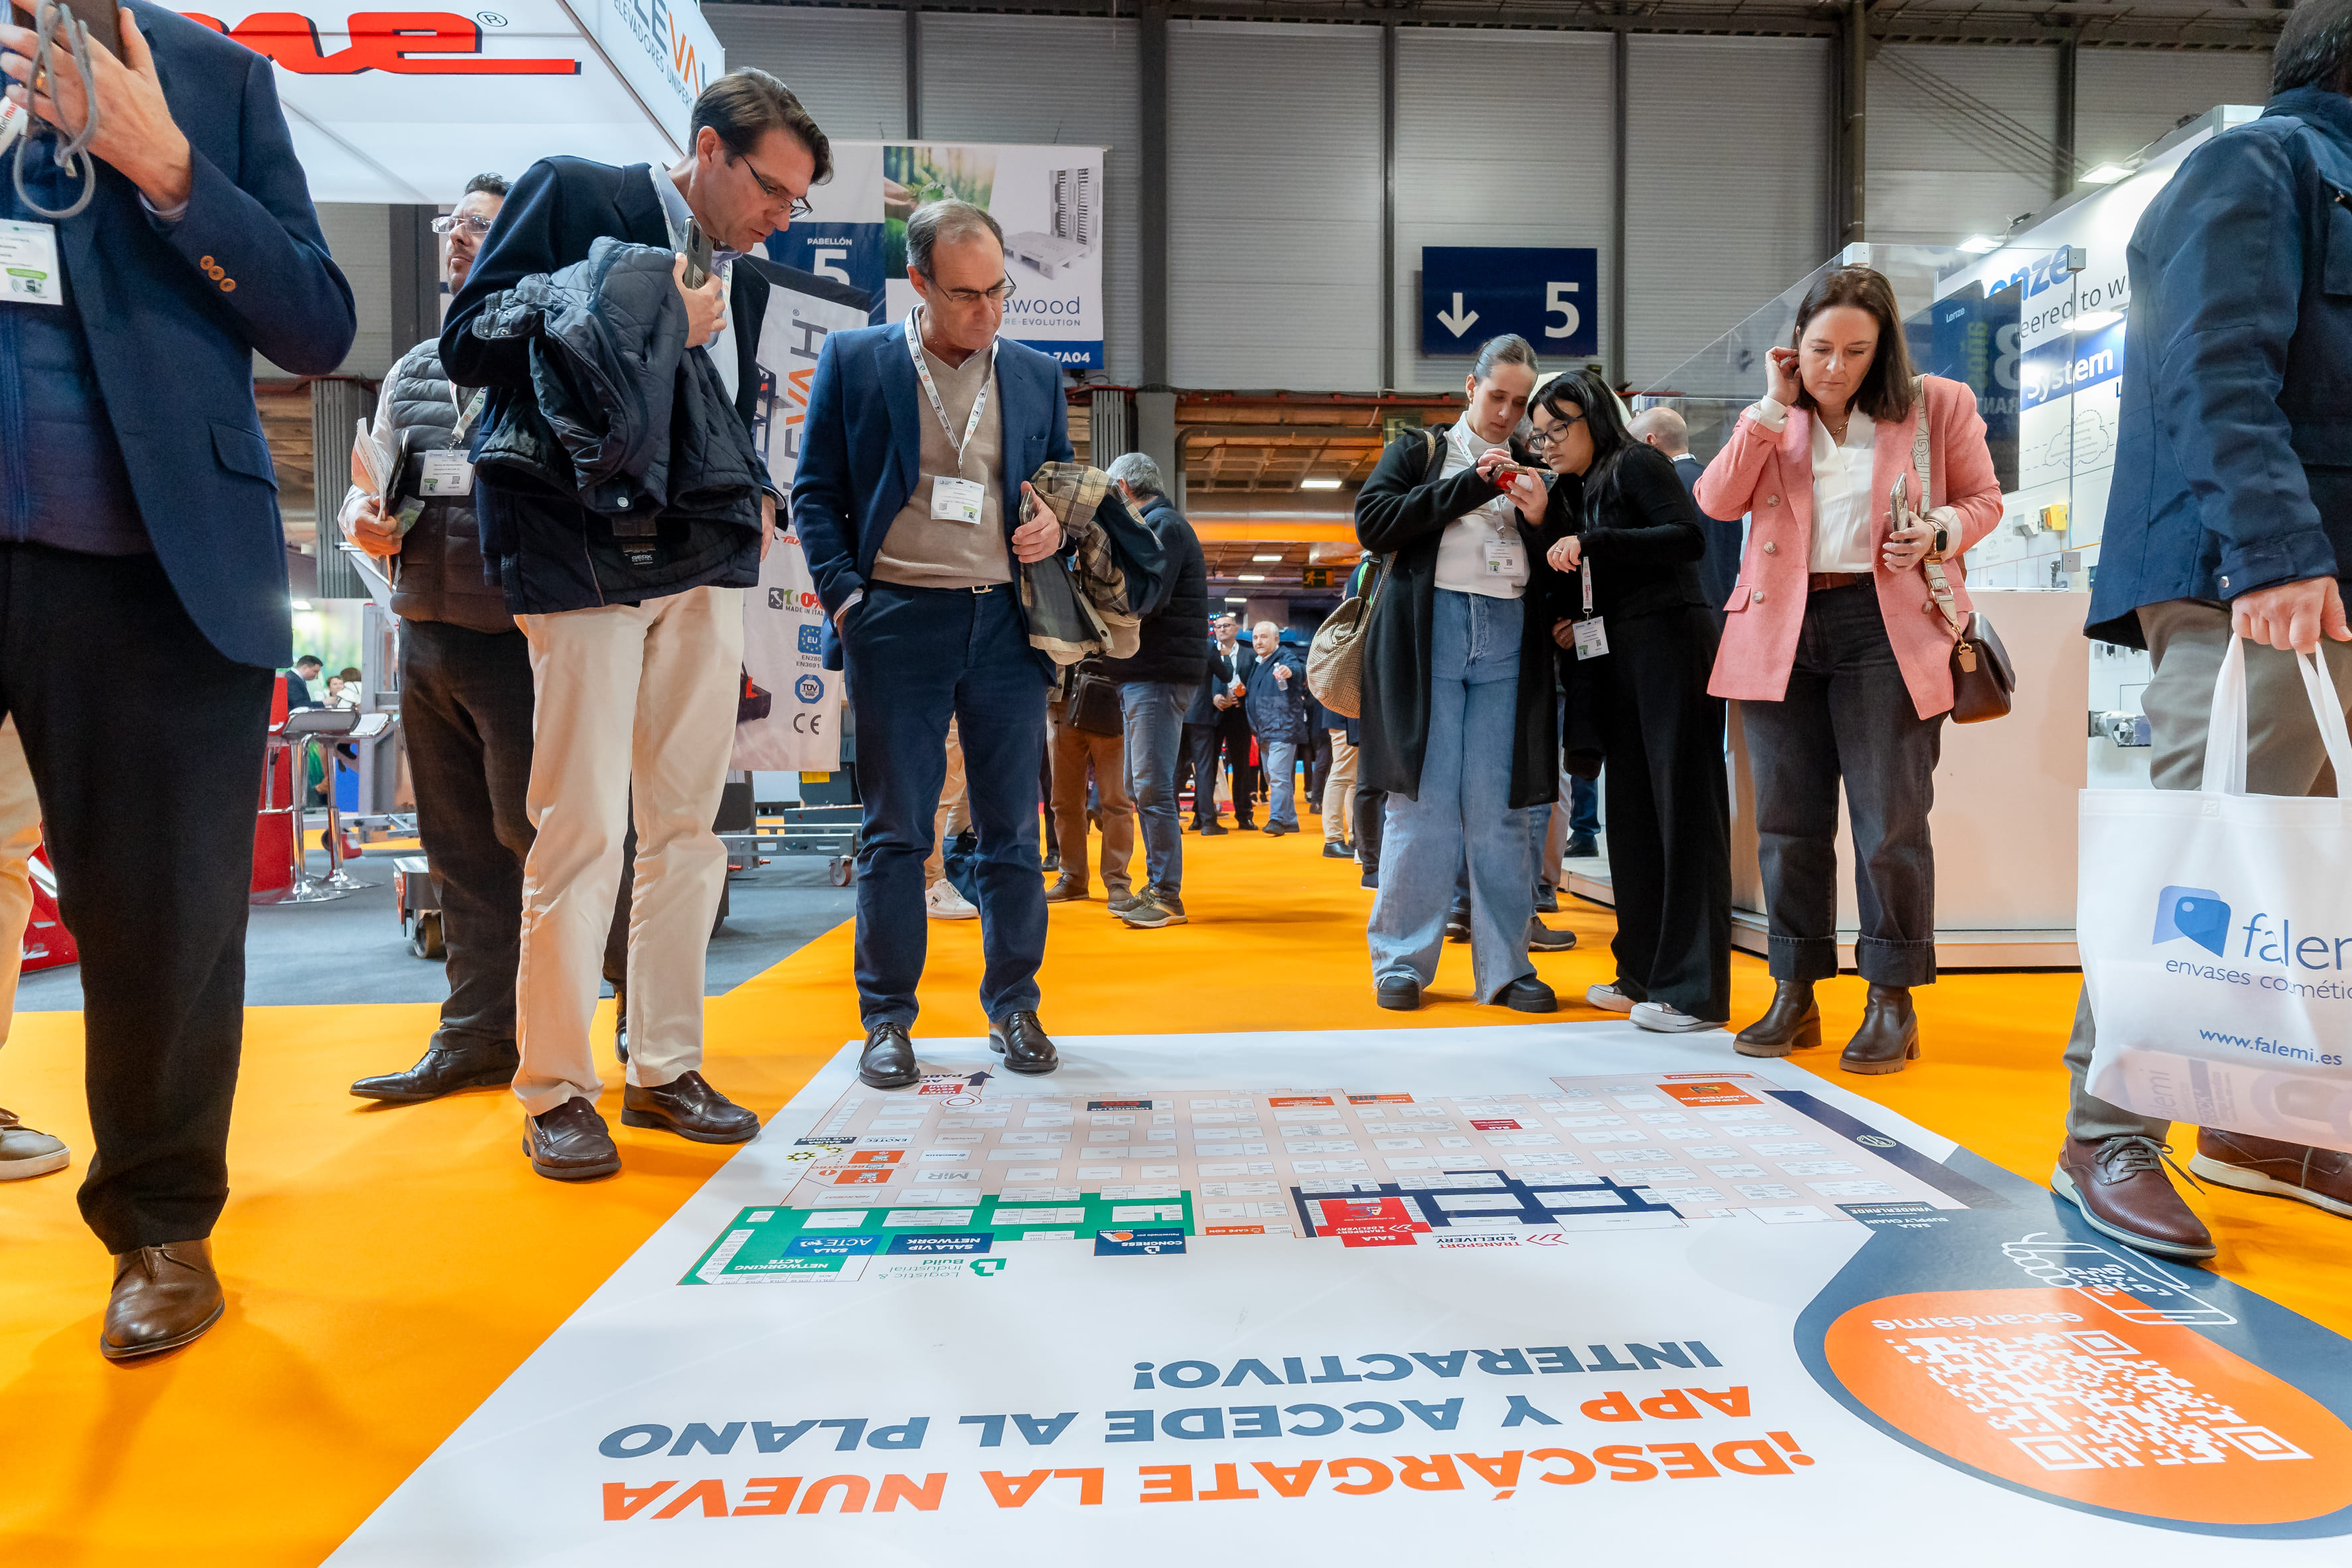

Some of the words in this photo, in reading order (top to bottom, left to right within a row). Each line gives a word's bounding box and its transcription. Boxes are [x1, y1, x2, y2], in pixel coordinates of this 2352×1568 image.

[814, 249, 850, 286] 5
[1544, 281, 1581, 339] 5
[2081, 288, 2101, 311] to
[2108, 275, 2130, 299] w
[1946, 307, 1965, 323] Lenze
[1054, 352, 1091, 363] 7A04
[793, 713, 822, 735] CE
[2165, 960, 2251, 985] envases
[2199, 1029, 2343, 1065] www.falemi.es
[1871, 1312, 2084, 1330] escanéame
[1134, 1340, 1723, 1389] INTERACTIVO!
[1105, 1398, 1464, 1442] ACCEDE
[1502, 1396, 1561, 1427] Y
[1581, 1387, 1751, 1421] APP
[599, 1417, 929, 1459] PLANO
[959, 1413, 1079, 1447] AL
[1139, 1432, 1815, 1502] ¡DESCÁRGATE
[603, 1474, 947, 1521] NUEVA
[980, 1468, 1104, 1507] LA
